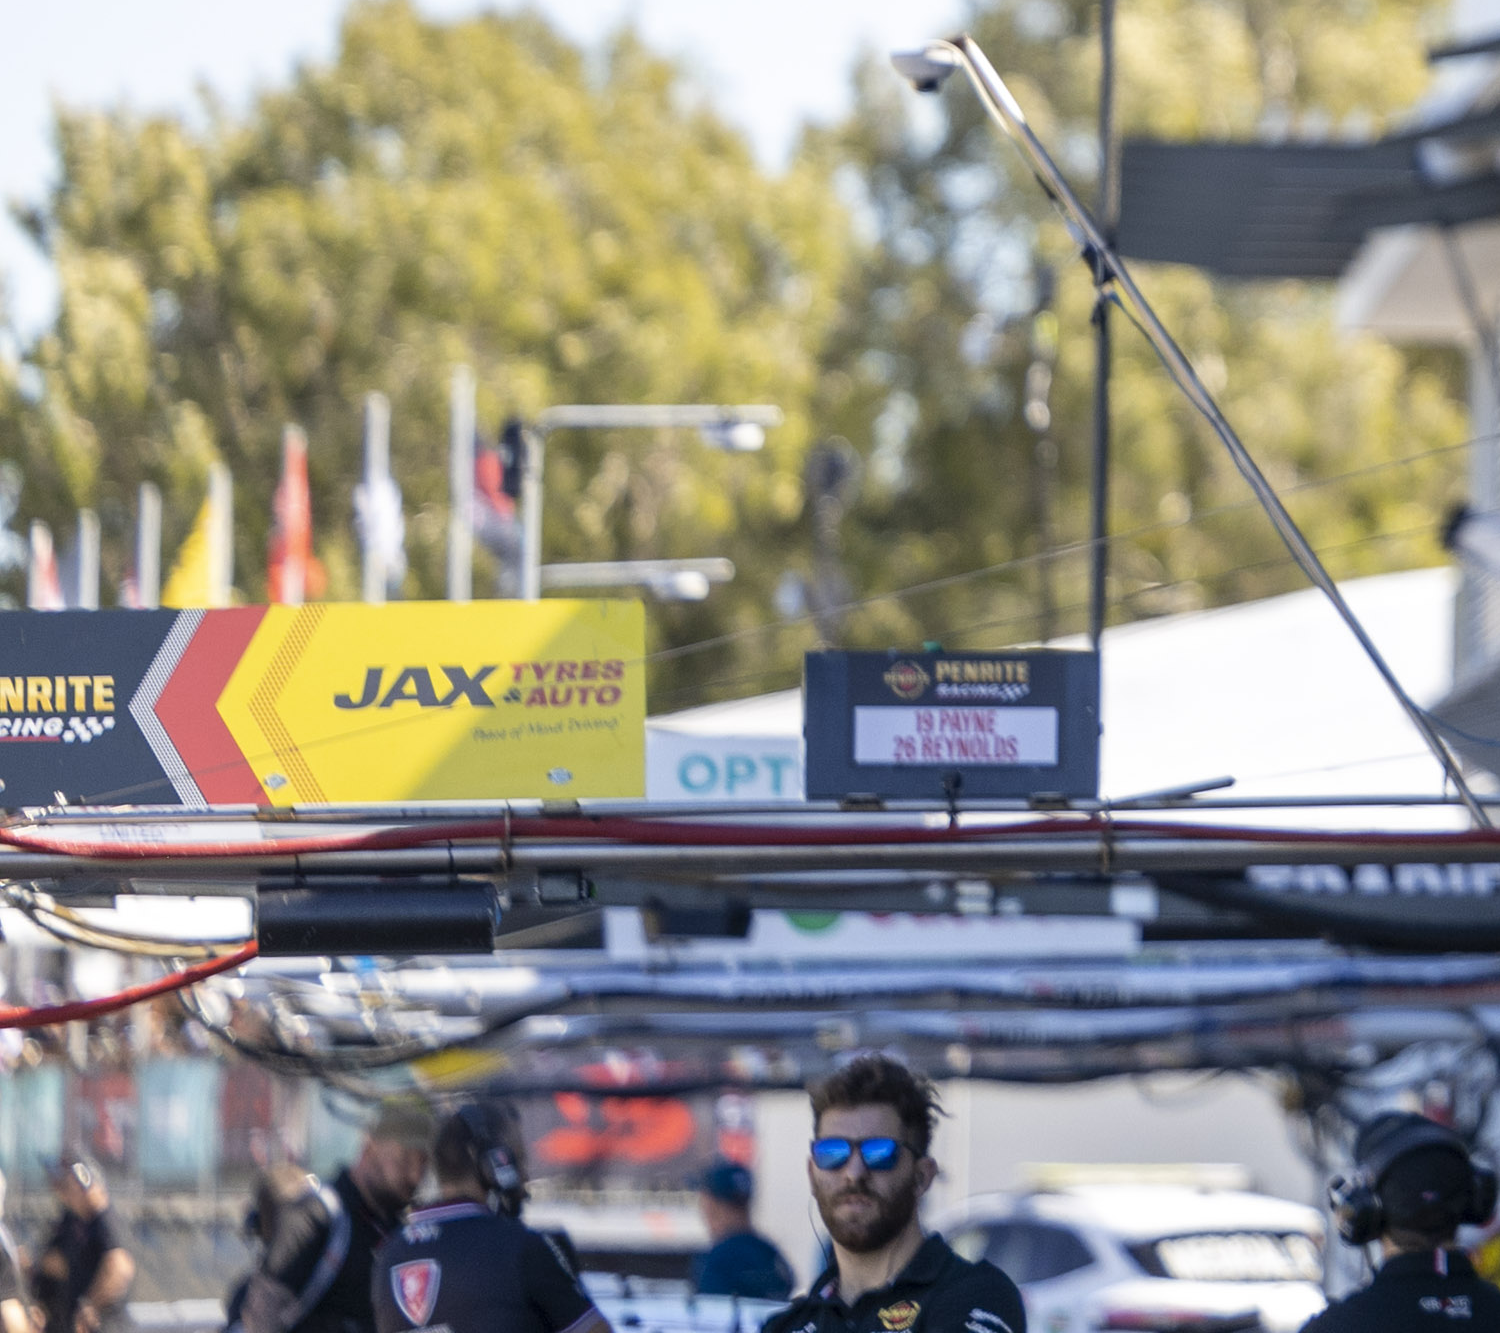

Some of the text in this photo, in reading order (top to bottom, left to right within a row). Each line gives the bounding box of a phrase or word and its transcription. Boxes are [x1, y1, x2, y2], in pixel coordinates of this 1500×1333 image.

[935, 660, 1031, 683] PENRITE
[334, 659, 625, 710] JAX TYRES
[525, 684, 623, 708] AUTO
[939, 709, 997, 734] PAYNE
[921, 735, 1019, 761] REYNOLDS
